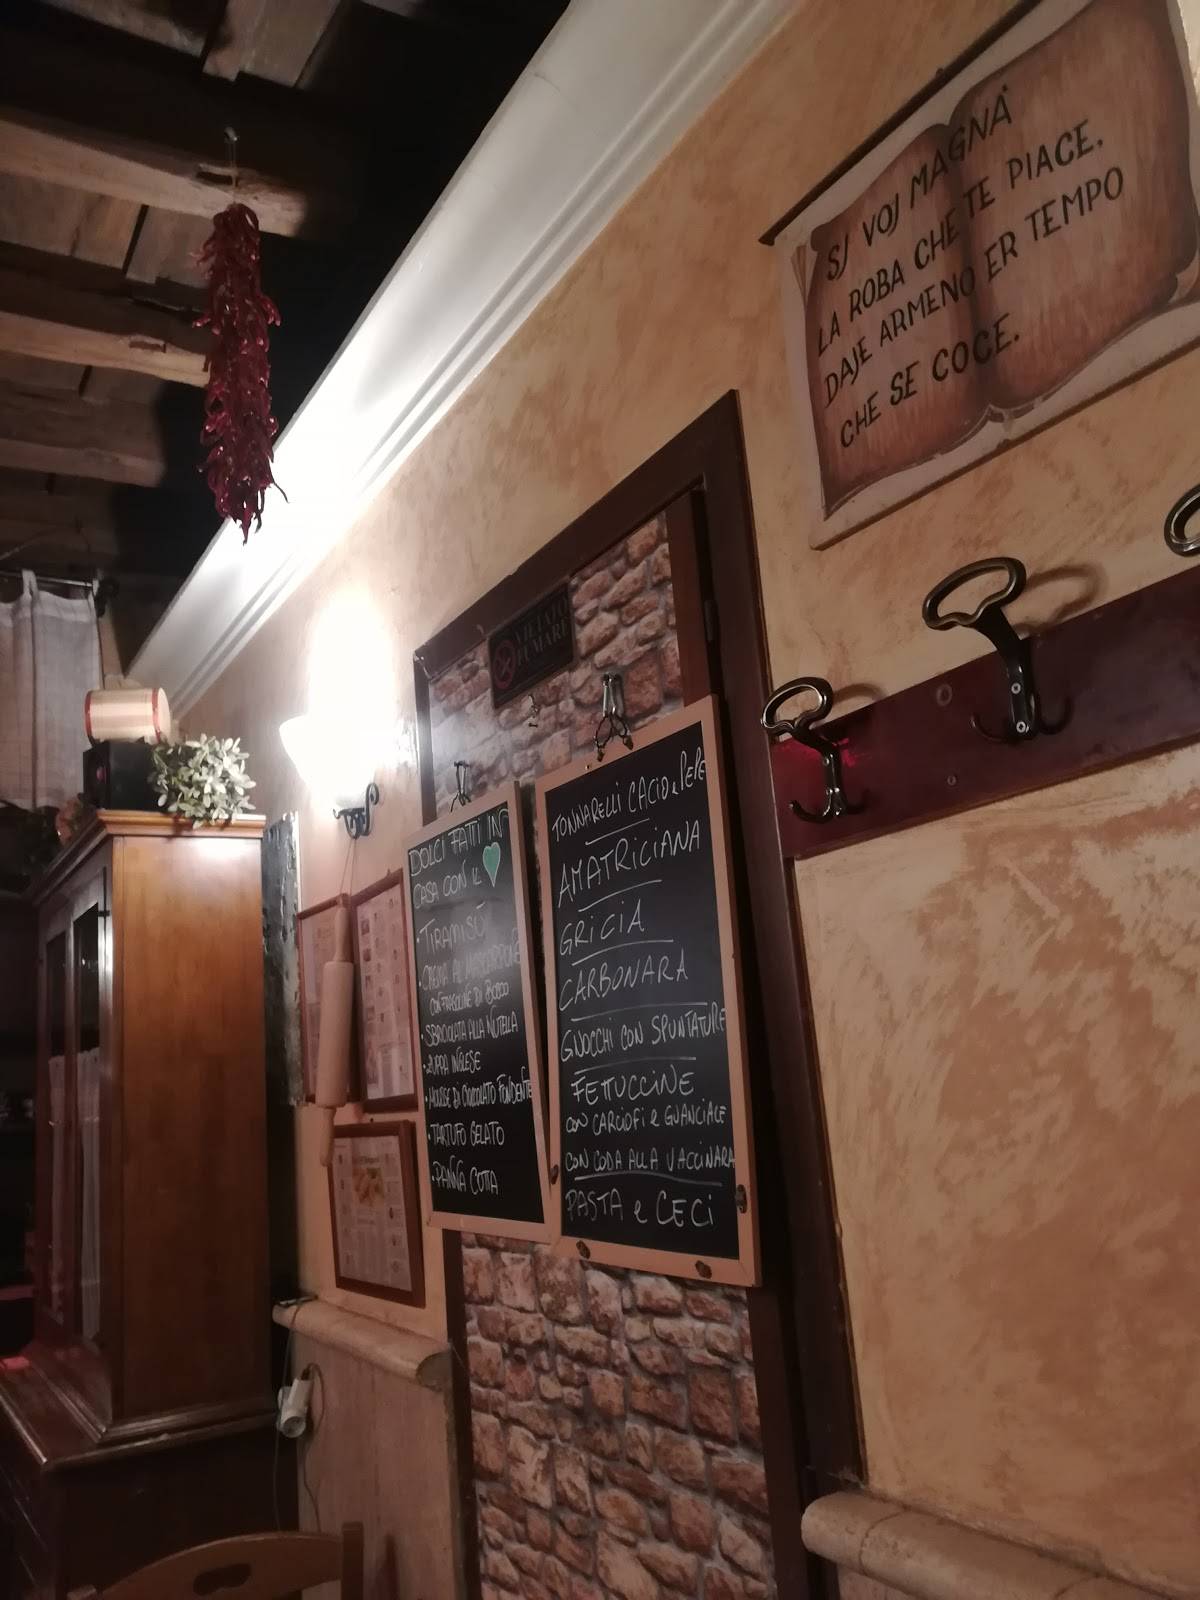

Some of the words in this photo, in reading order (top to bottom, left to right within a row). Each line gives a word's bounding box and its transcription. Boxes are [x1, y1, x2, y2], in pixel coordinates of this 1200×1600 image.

[817, 315, 841, 356] LA
[848, 264, 905, 322] ROBA
[914, 207, 959, 270] CHE
[962, 177, 996, 218] TE
[1007, 118, 1104, 190] PIACE.
[824, 335, 873, 409] DAJE
[879, 264, 976, 347] ARMENO
[983, 230, 1019, 283] ER
[1024, 165, 1124, 242] TEMPO
[840, 393, 882, 449] CHE
[889, 360, 920, 407] SE
[931, 312, 1021, 383] COCE.
[551, 781, 622, 842] TONNARELLI
[627, 776, 669, 812] CACIO
[408, 837, 445, 877] DOLCI
[447, 818, 480, 855] FATTI
[558, 820, 701, 909] AMATRICIANA
[412, 880, 440, 910] CASA
[442, 859, 467, 898] CON
[559, 898, 646, 956] GRICIA
[559, 947, 689, 1011] CARBONARA
[620, 1021, 645, 1051] CON
[570, 1064, 695, 1106] FETTUCCINE
[429, 1123, 467, 1148] TARTUFO
[469, 1120, 506, 1148] GELATO
[565, 1148, 589, 1173] CON
[593, 1149, 623, 1173] CODA
[628, 1147, 659, 1172] ALLA
[666, 1140, 736, 1173] VACCINARA
[565, 1187, 624, 1222] PASTA
[656, 1189, 715, 1228] CECI
